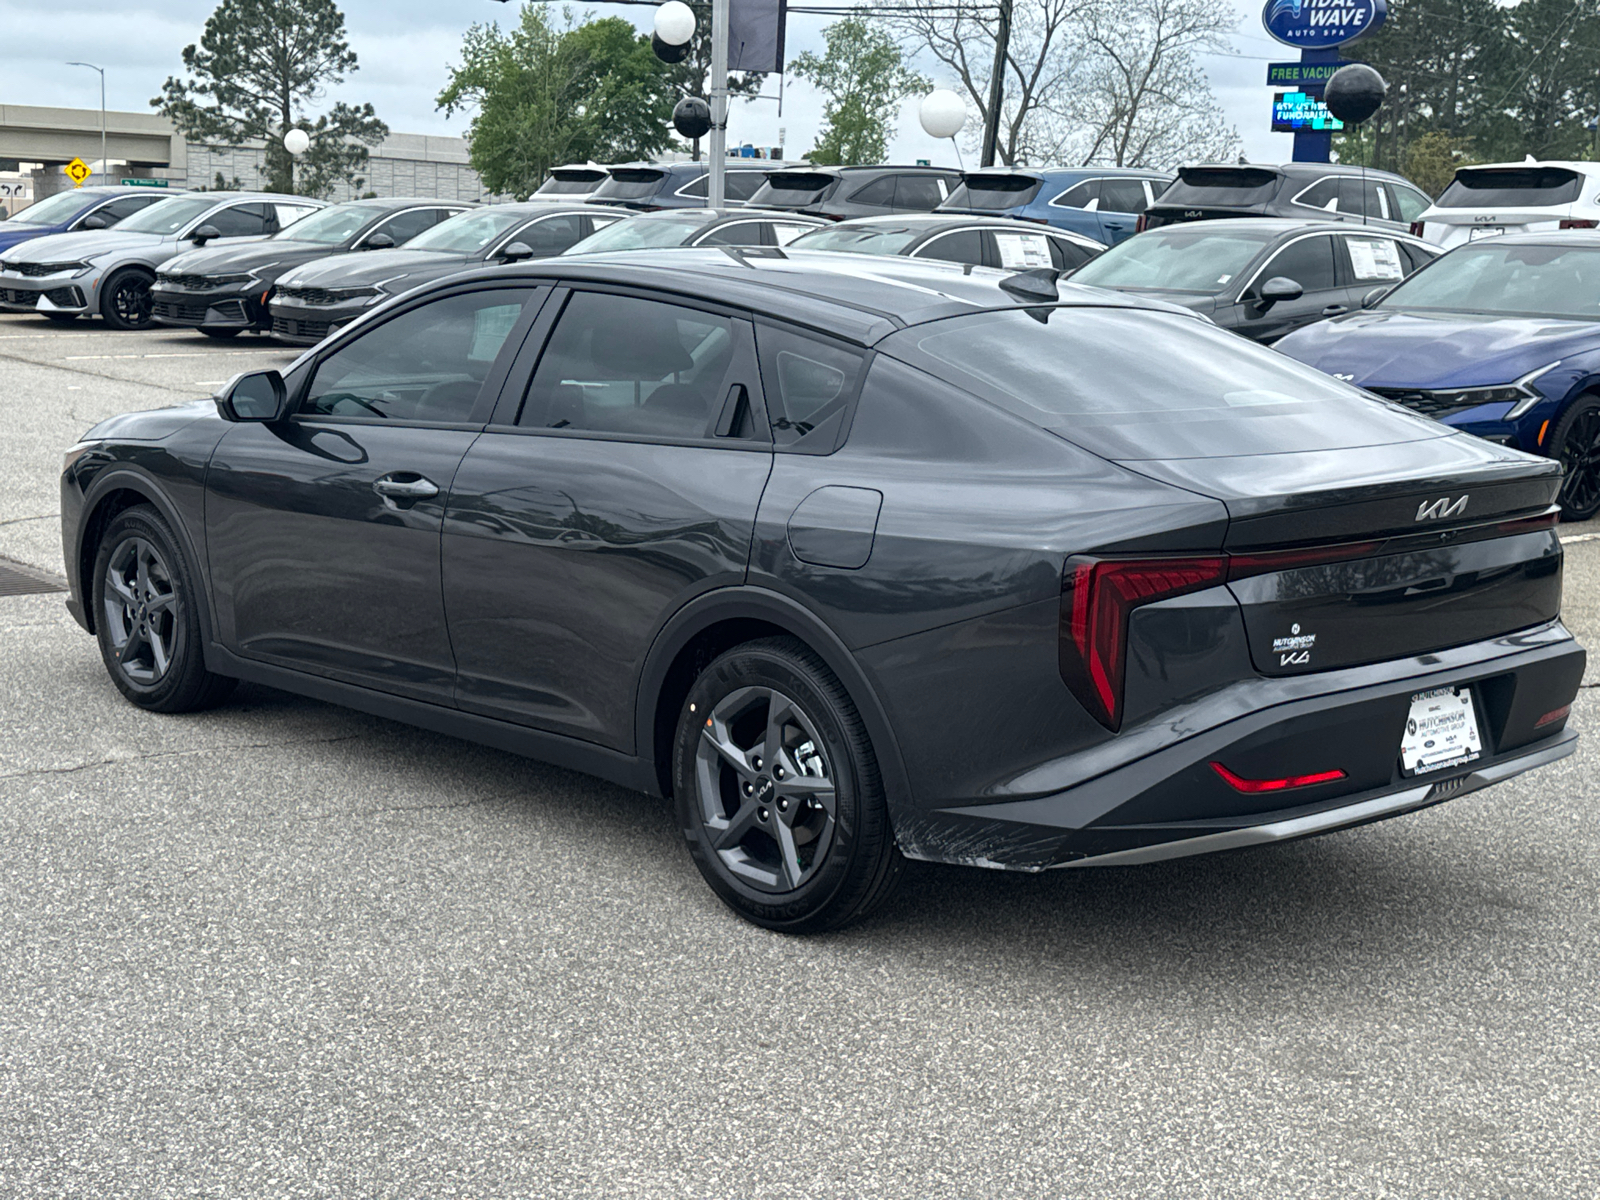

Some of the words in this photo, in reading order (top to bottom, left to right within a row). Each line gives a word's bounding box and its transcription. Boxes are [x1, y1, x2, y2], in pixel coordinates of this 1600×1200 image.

[1310, 8, 1366, 26] WAVE
[1271, 67, 1300, 80] FREE
[1277, 110, 1335, 120] FUNDRAISIN
[1415, 494, 1470, 522] KIA
[1280, 650, 1310, 666] K4
[1418, 711, 1466, 731] HUTCHINSON
